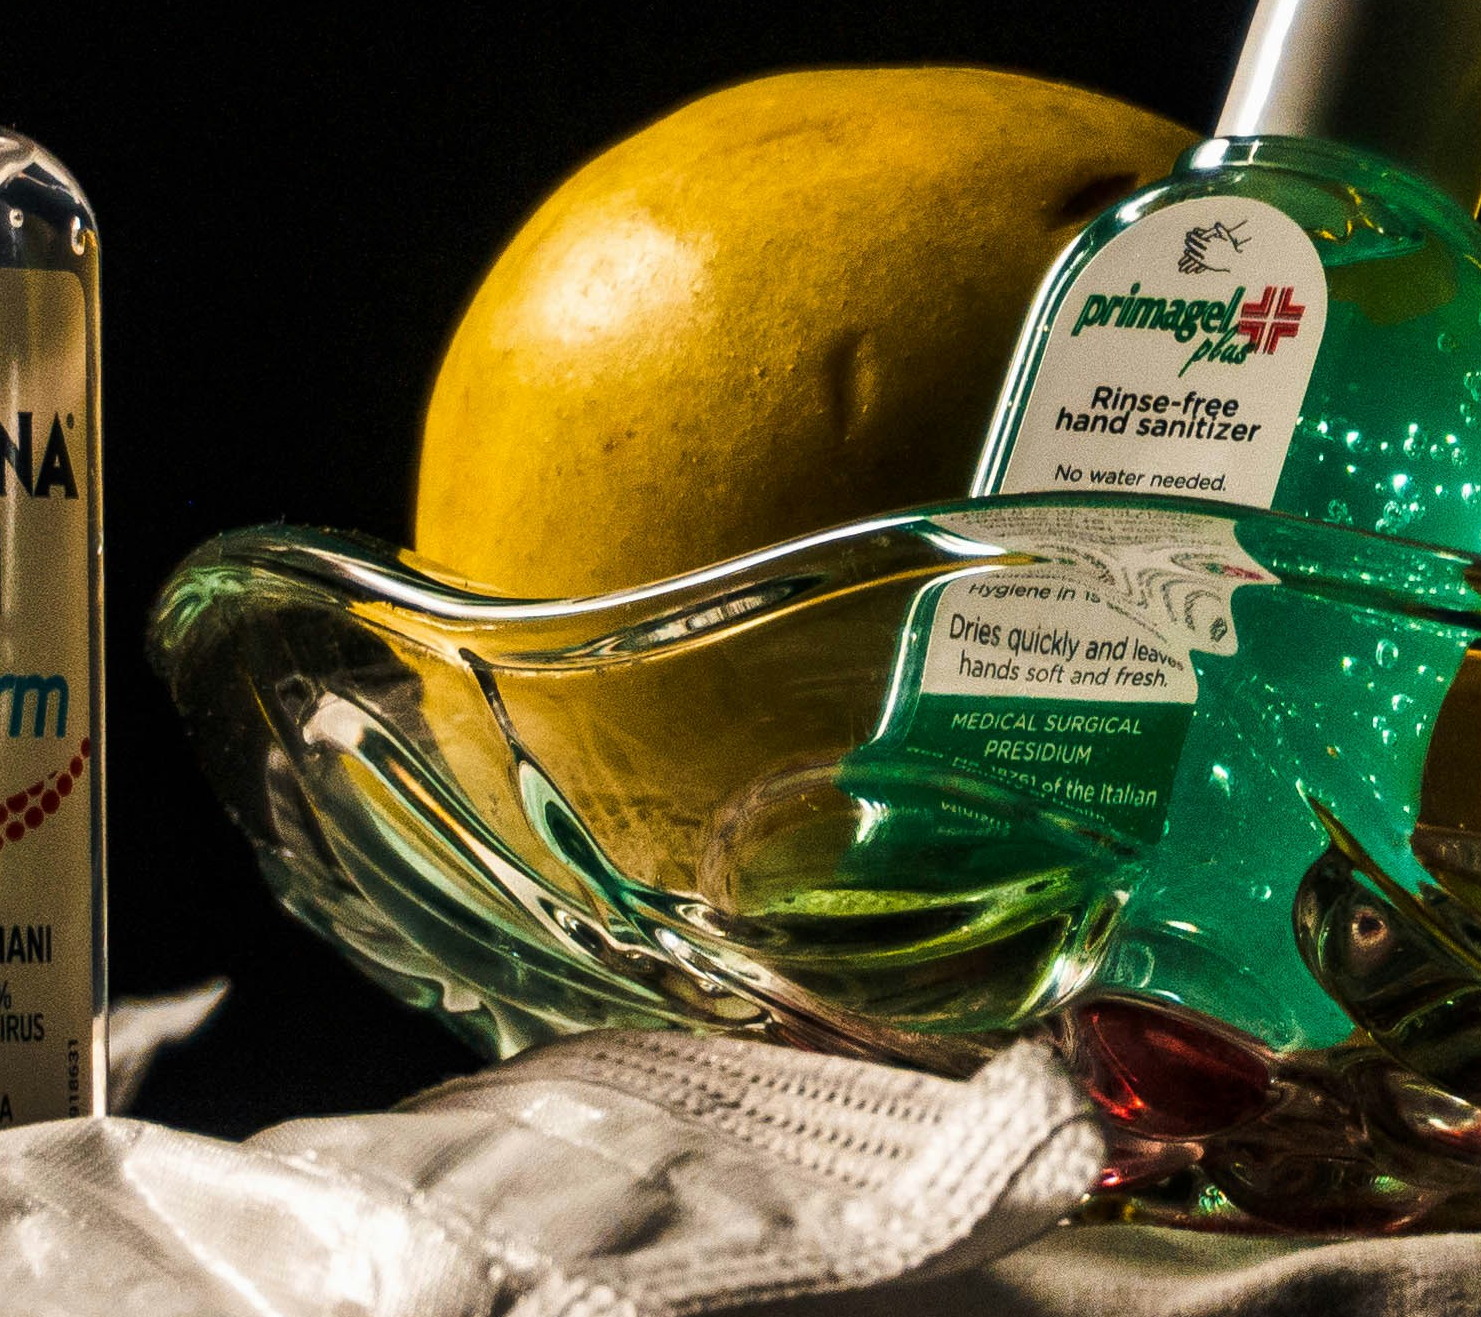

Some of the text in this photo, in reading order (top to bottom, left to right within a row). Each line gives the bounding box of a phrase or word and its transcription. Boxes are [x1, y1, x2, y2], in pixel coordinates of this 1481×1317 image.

[1071, 282, 1247, 343] primagel
[1178, 320, 1257, 377] plus
[1091, 386, 1240, 419] Rinse-free
[1055, 406, 1262, 442] hand sanitizer
[1054, 465, 1228, 492] No water needed.
[949, 613, 1001, 647] Dries
[1007, 624, 1080, 664] quickly
[1085, 636, 1129, 661] and
[958, 649, 1169, 689] hands soft and fresh.
[949, 711, 1143, 735] MEDICAL SURGICAL
[983, 739, 1093, 766] PRESIDIUM
[1041, 776, 1064, 794] of
[1065, 779, 1095, 804] the
[1100, 783, 1158, 807] Italian
